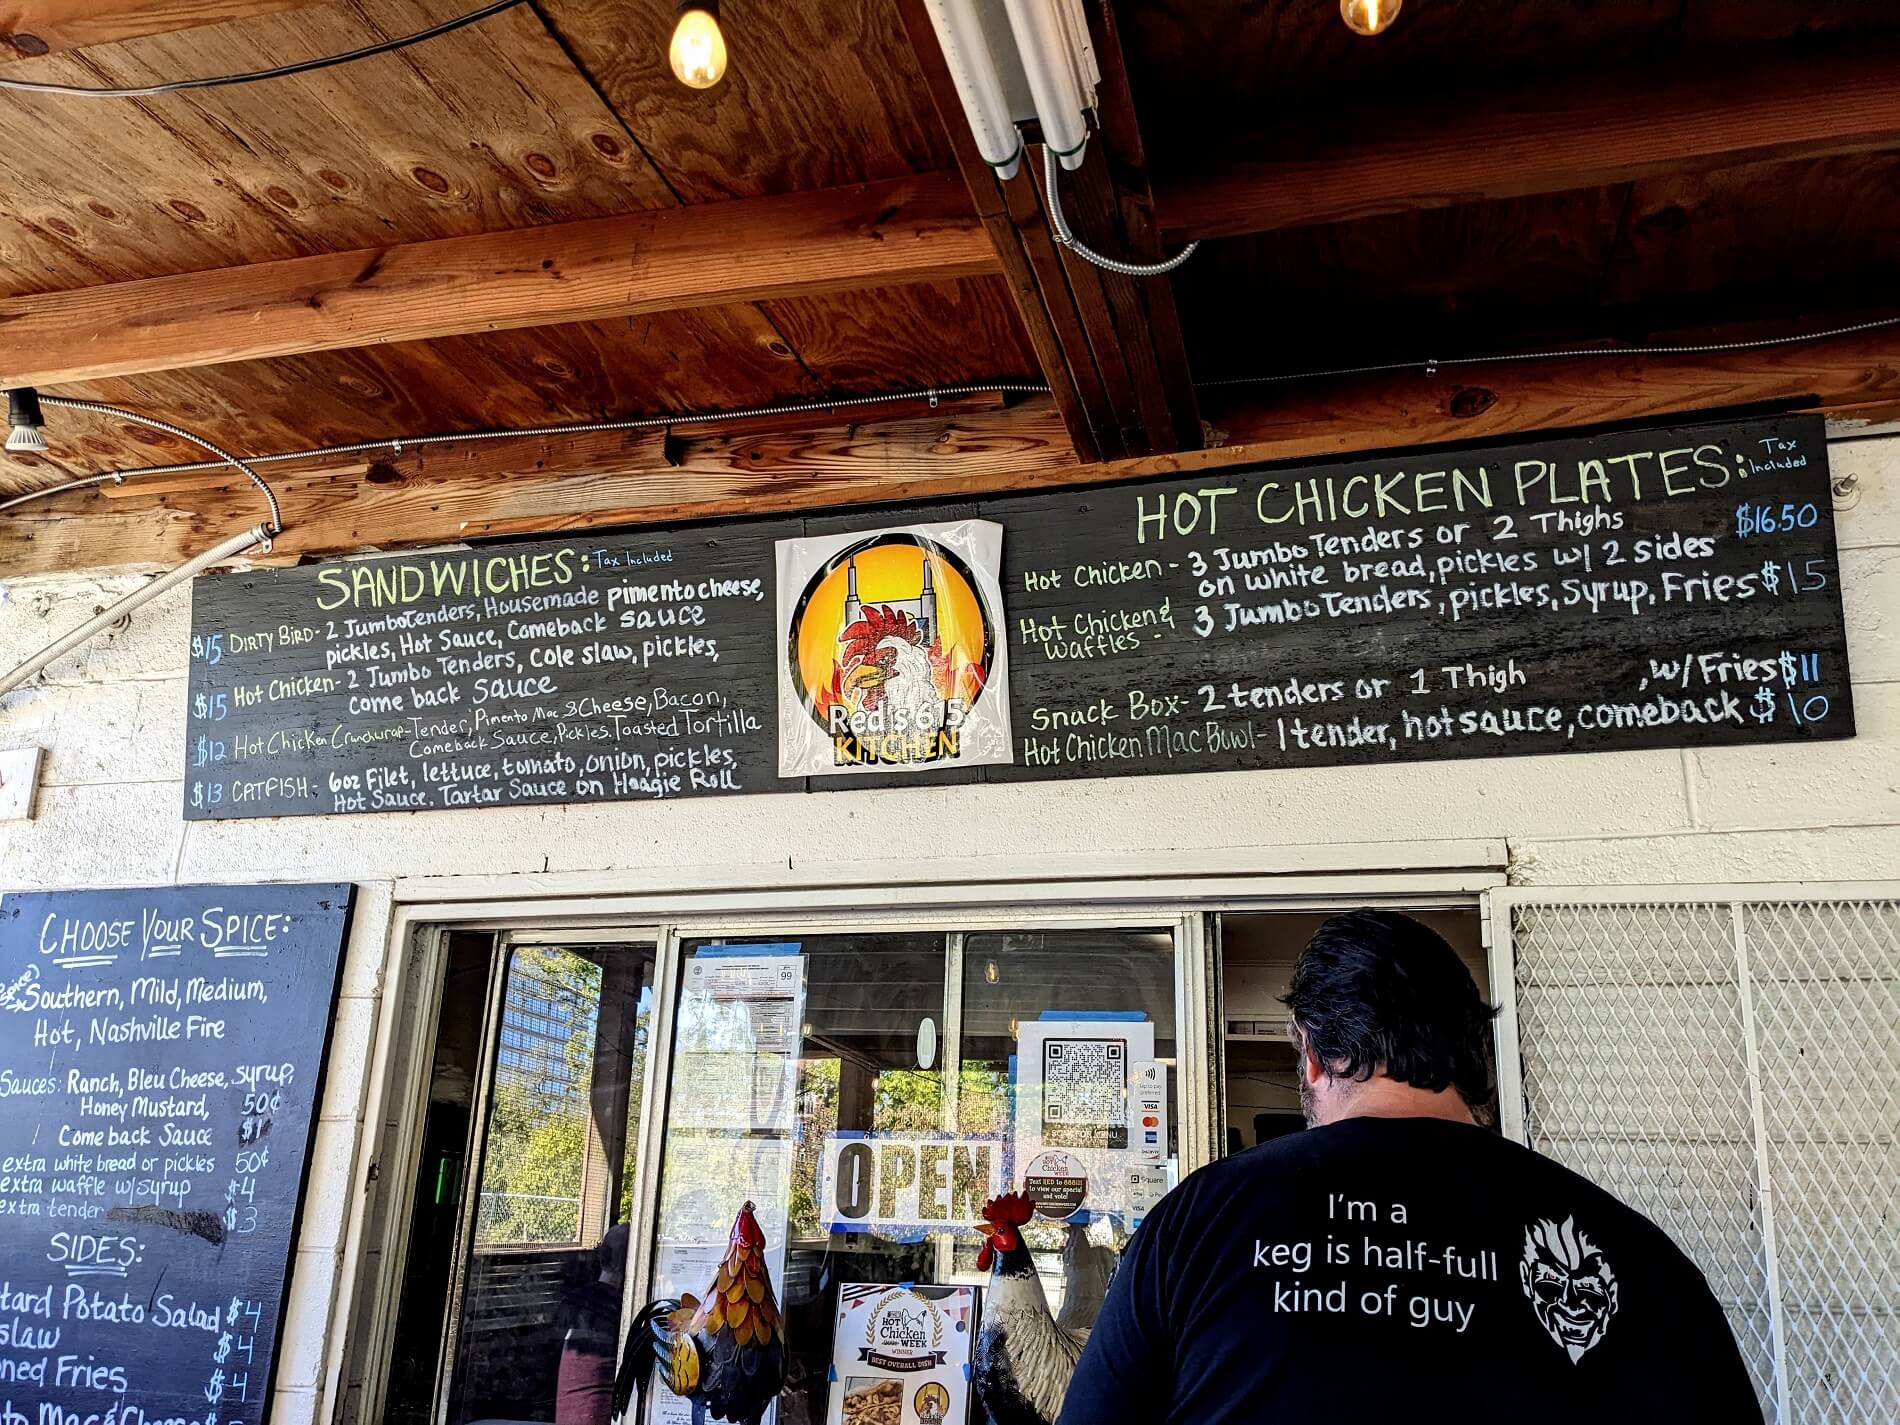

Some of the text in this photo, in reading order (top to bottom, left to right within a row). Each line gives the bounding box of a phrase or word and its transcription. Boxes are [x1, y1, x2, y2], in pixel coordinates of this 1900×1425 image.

[1749, 455, 1807, 475] Included
[1758, 438, 1797, 455] Tax
[1137, 443, 1749, 544] HOT CHICKEN PLATES:
[1735, 502, 1818, 538] $16.50
[592, 550, 673, 569] Tax Included
[1024, 504, 1624, 593] Hot 3 Jumbo Tenders or 2 Thighs
[1198, 533, 1716, 597] on white bread, pickles w/ 2 sides
[316, 548, 590, 611] SANDWICHES:
[1019, 560, 1826, 645] Hot Chicken 3 pickles, Syrup, Fries $15
[191, 586, 600, 665] $15 DIRTY 2 Housemade
[326, 605, 705, 670] pickles, Hot Sauce, Comeback sauce
[192, 693, 227, 721] $15
[234, 686, 264, 708] Hot
[347, 670, 359, 689] 2
[365, 666, 432, 689] Jumbo
[436, 650, 524, 674] Tenders,
[530, 645, 574, 668] cole
[581, 641, 638, 666] slaw,
[643, 635, 720, 668] pickles,
[348, 675, 558, 715] come back sauce
[1031, 699, 1119, 731] Snack
[1197, 685, 1226, 713] 2
[1228, 677, 1345, 709] tenders
[1355, 677, 1391, 700] or
[1410, 668, 1431, 694] 1
[1441, 659, 1528, 693] Thigh
[1697, 651, 1778, 686] Fries
[1778, 650, 1819, 689] $11
[193, 687, 727, 768] $12 Hot Chicken Tender, Pimento Mac Bacon,
[409, 709, 762, 758] Comeback Sauce, Toasted Tortilla
[828, 697, 966, 735] Red's 615
[1024, 686, 1829, 768] Hot Chicken Mac 1 tender, comeback $10
[834, 729, 960, 767] KITCHEN
[190, 743, 738, 808] $13 6oz Filet, lettuce, tomato, onion, pickles,
[334, 793, 366, 812] Hot
[438, 784, 503, 806] Tartar
[509, 778, 566, 799] Sauce
[575, 779, 604, 797] on
[689, 767, 741, 791] Roll
[39, 906, 291, 961] CHOOSE YOUR SPICE:
[24, 983, 124, 1012] Southern,
[131, 977, 182, 1011] Mild,
[186, 977, 268, 1003] Medium,
[781, 971, 792, 981] 99
[34, 1014, 225, 1051] Hot, Nashville Fire
[67, 1069, 123, 1097] Ranch,
[127, 1066, 166, 1090] Bleu
[169, 1066, 229, 1089] Cheese,
[80, 1097, 128, 1122] Honey
[131, 1093, 210, 1121] Mustard,
[158, 1122, 212, 1147] Sauce
[2, 1153, 46, 1174] extra
[54, 1153, 92, 1173] white
[96, 1151, 136, 1172] bread
[142, 1156, 156, 1172] or
[164, 1152, 215, 1180] pickles
[836, 1142, 991, 1221] OPEN
[1141, 1176, 1164, 1185] Square
[0, 1175, 255, 1203] extra waffle $4
[47, 1200, 104, 1219] tender
[223, 1206, 258, 1233] $3
[1329, 1193, 1408, 1224] I'm a
[46, 1232, 146, 1266] SIDES:
[1253, 1235, 1497, 1281] keg is half-full
[63, 1283, 262, 1334] Potato Salad $4
[882, 1317, 901, 1326] HOT
[1274, 1281, 1475, 1333] kind of guy
[213, 1330, 254, 1365] $4
[880, 1327, 926, 1340] Chicken
[901, 1340, 927, 1348] WEEK
[55, 1355, 248, 1403] Fries $4
[887, 1360, 916, 1368] OVERALL
